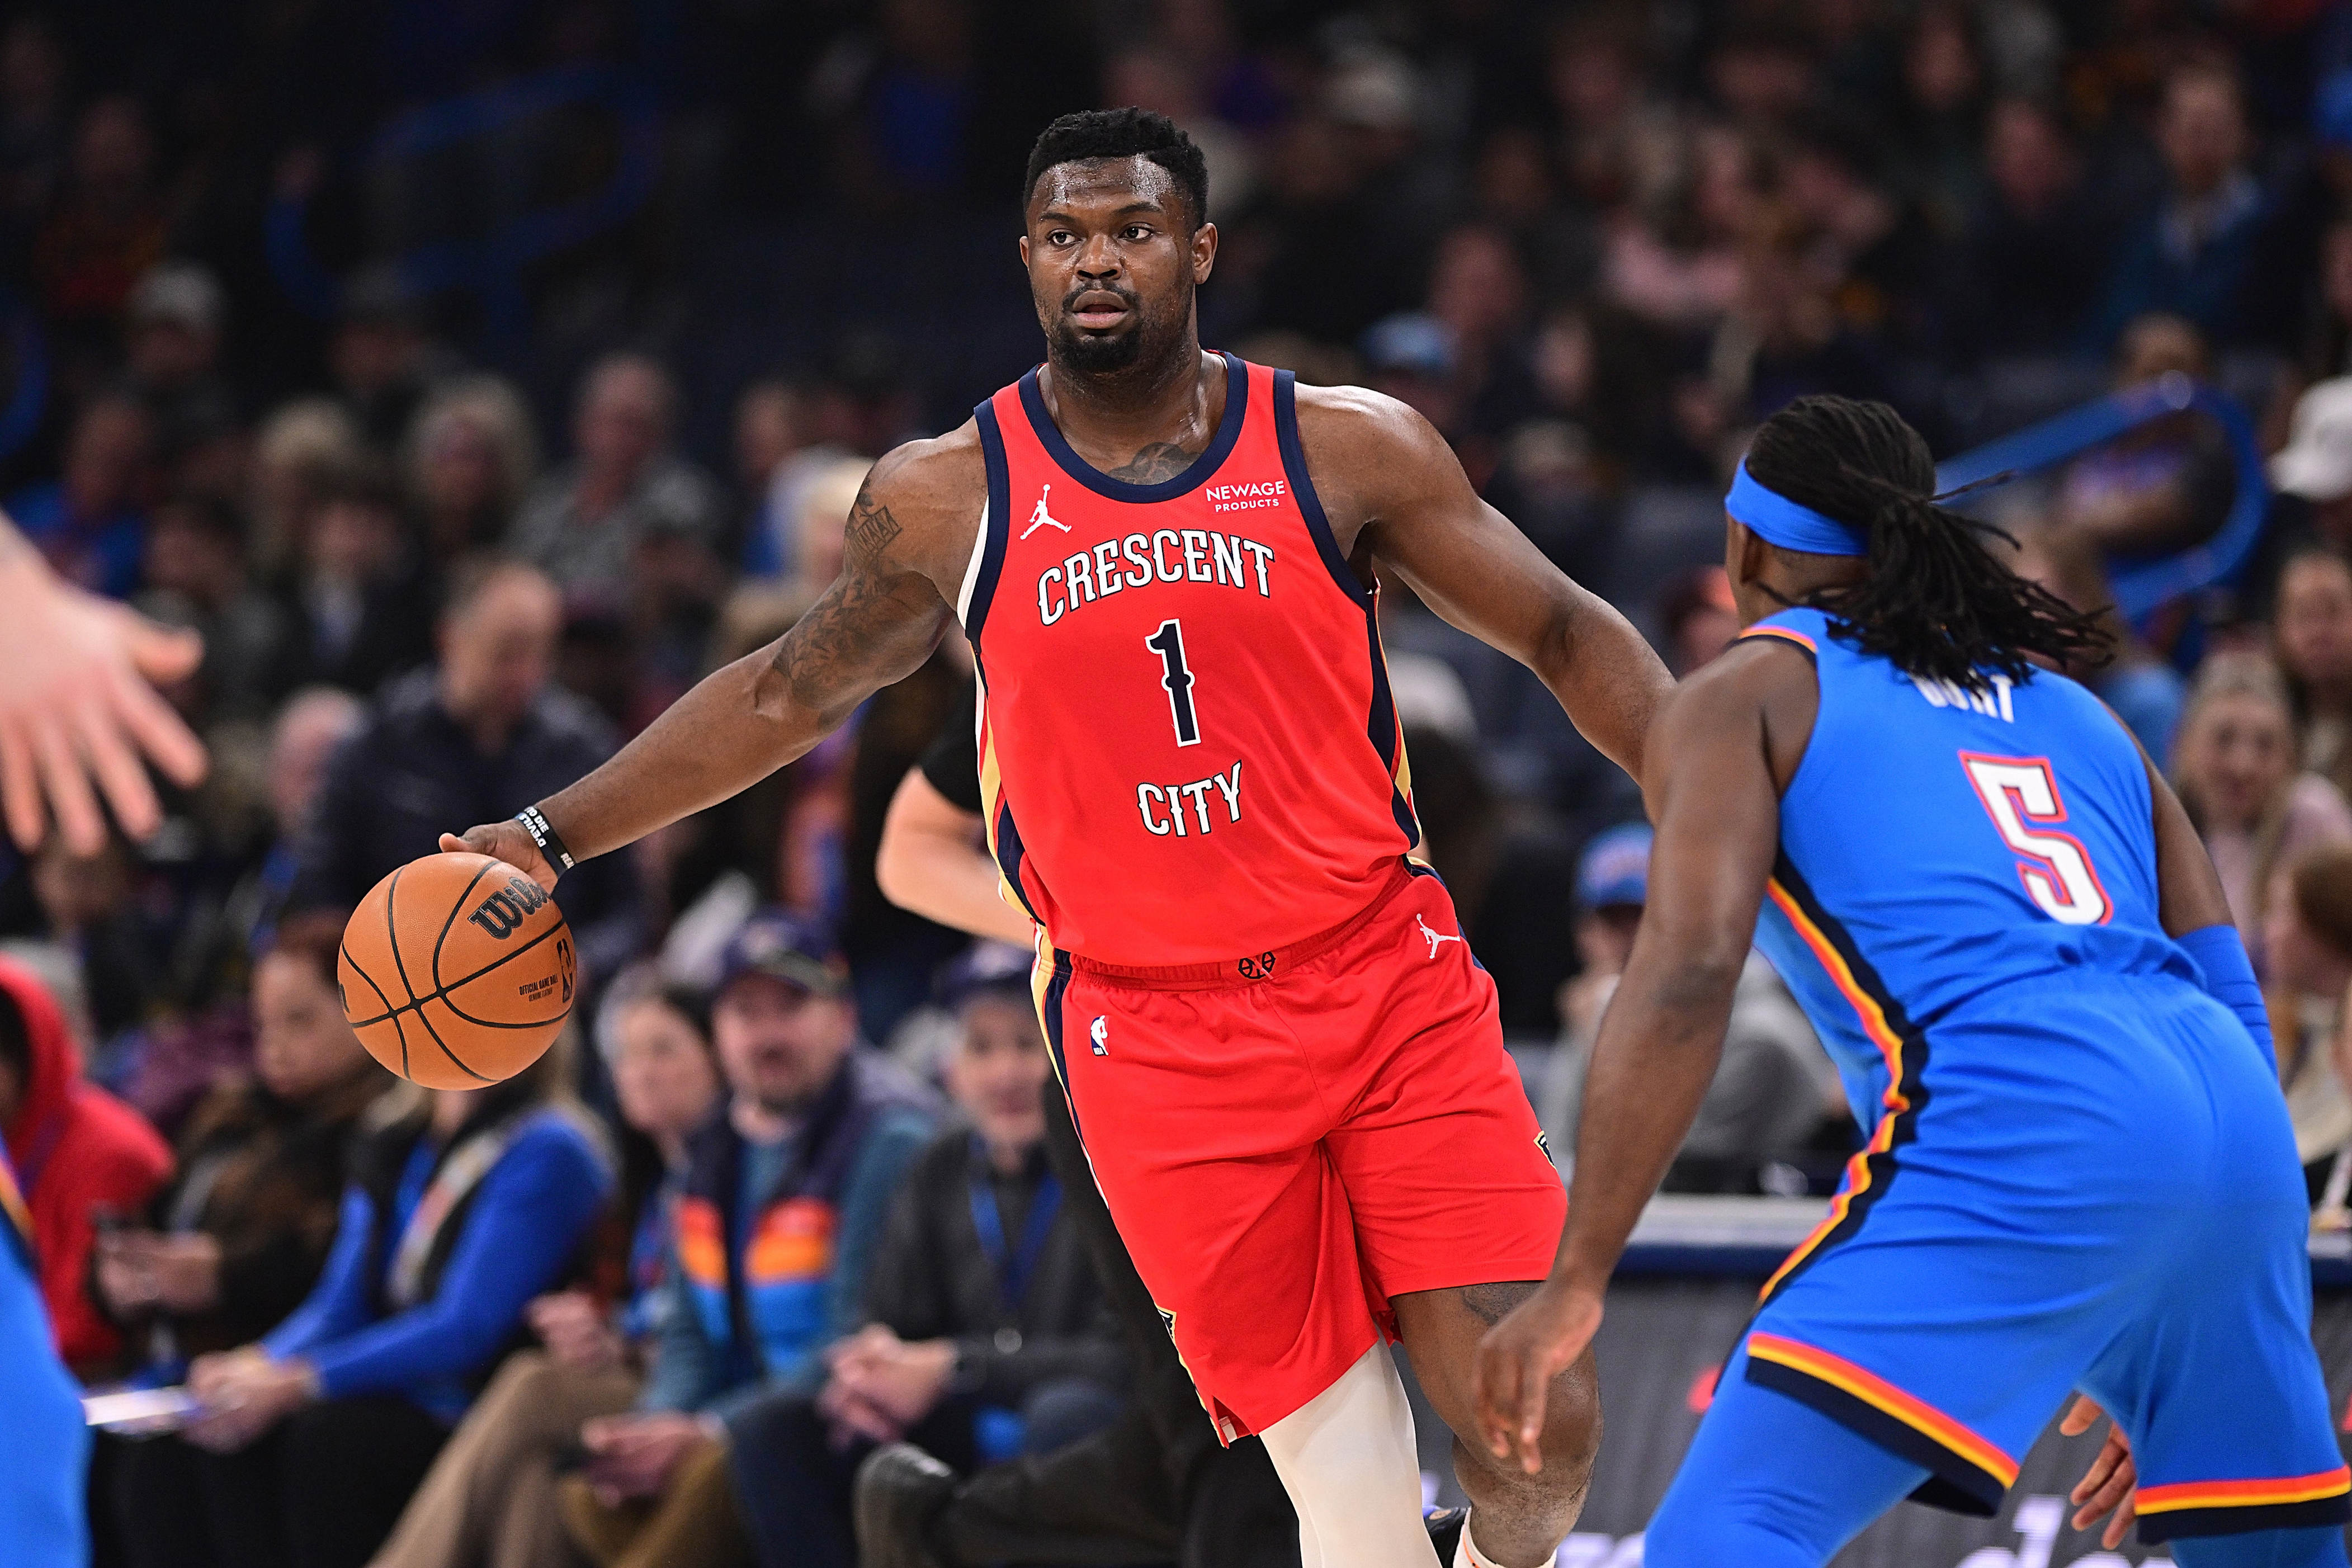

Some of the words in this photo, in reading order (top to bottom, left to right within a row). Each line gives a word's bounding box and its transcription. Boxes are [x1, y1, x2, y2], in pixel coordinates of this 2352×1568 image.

[1206, 480, 1286, 502] NEWAGE
[1215, 498, 1279, 513] PRODUCTS
[1037, 528, 1275, 626] CRESCENT
[1145, 618, 1201, 748] 1
[1137, 759, 1242, 837] CITY
[519, 813, 547, 847] D'EVILS
[534, 815, 549, 833] DIE
[1958, 750, 2114, 926] 5
[519, 981, 539, 995] OFFICIAL
[539, 977, 550, 989] GAME
